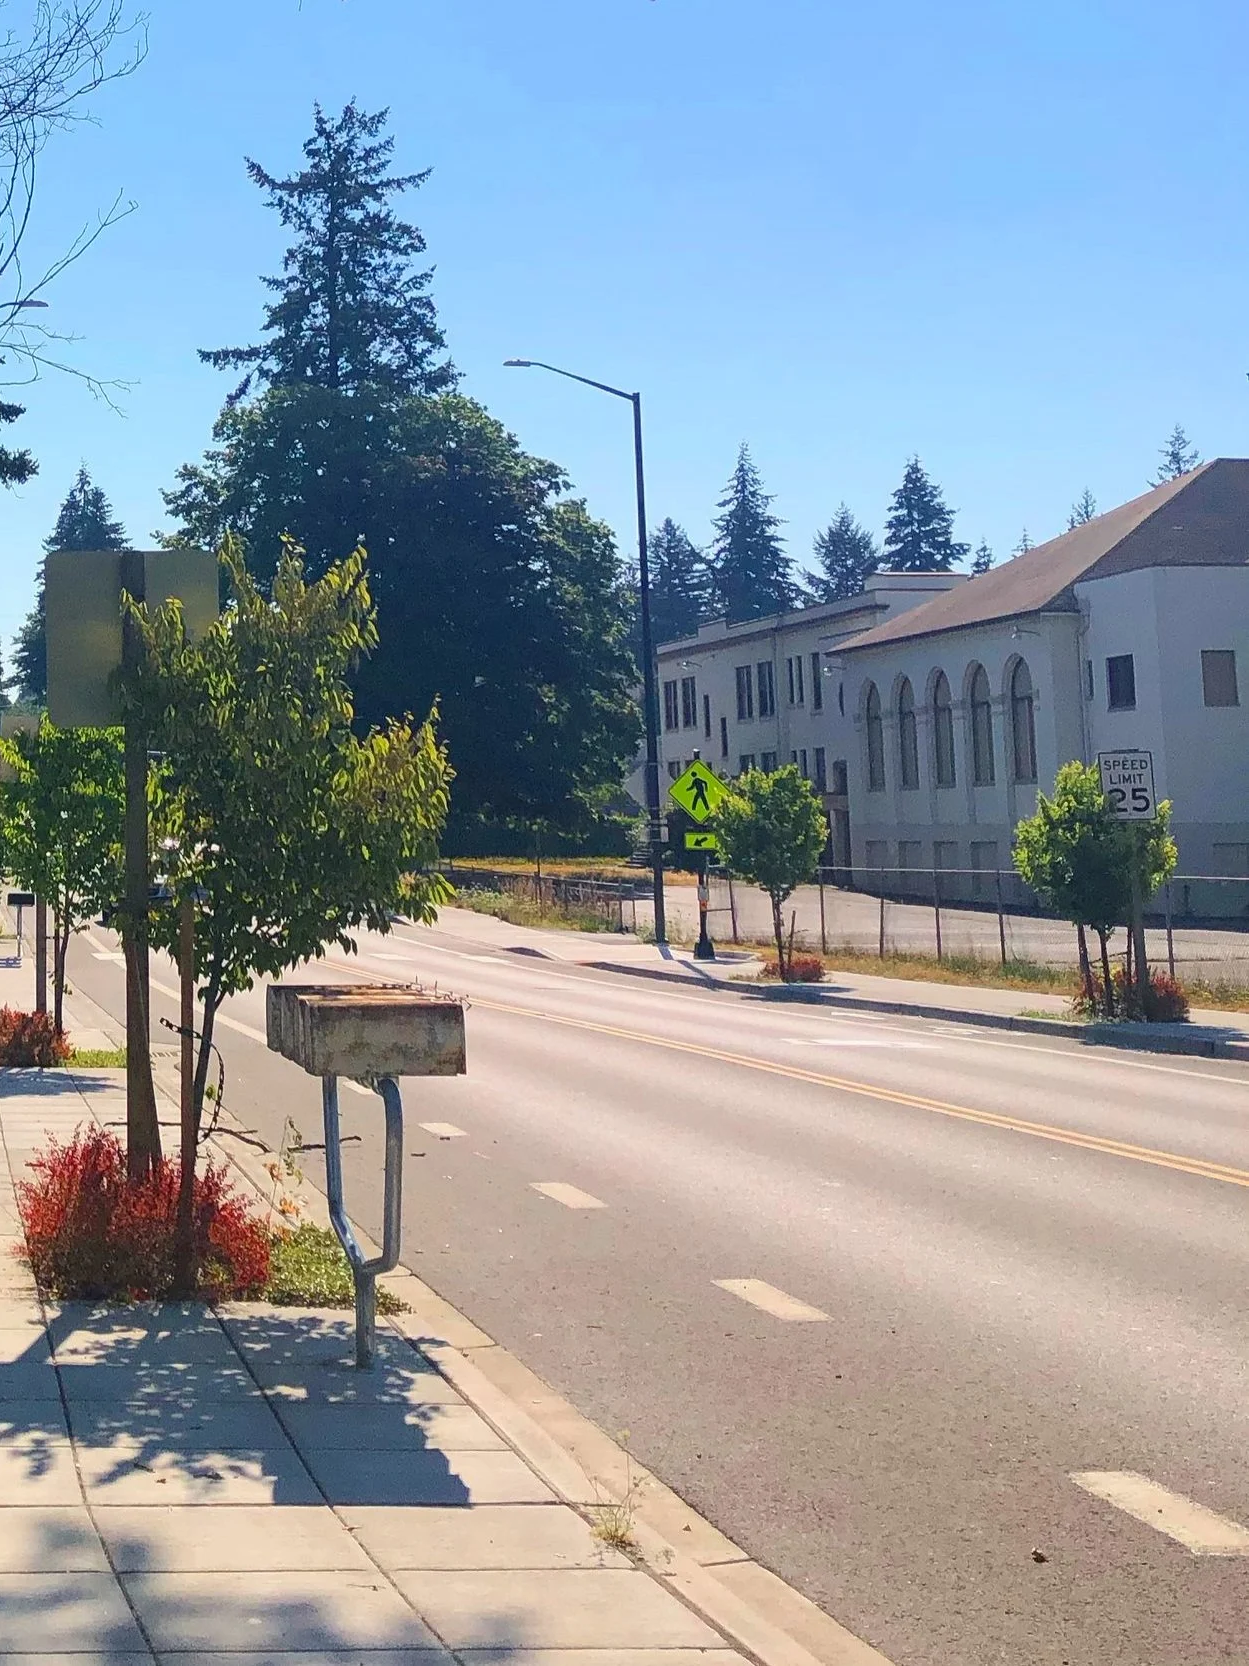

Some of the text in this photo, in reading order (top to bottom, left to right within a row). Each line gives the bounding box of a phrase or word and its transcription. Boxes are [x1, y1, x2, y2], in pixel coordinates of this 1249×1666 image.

[1103, 760, 1148, 770] SPEED
[1109, 774, 1144, 784] LIMIT
[1107, 788, 1150, 812] 25
